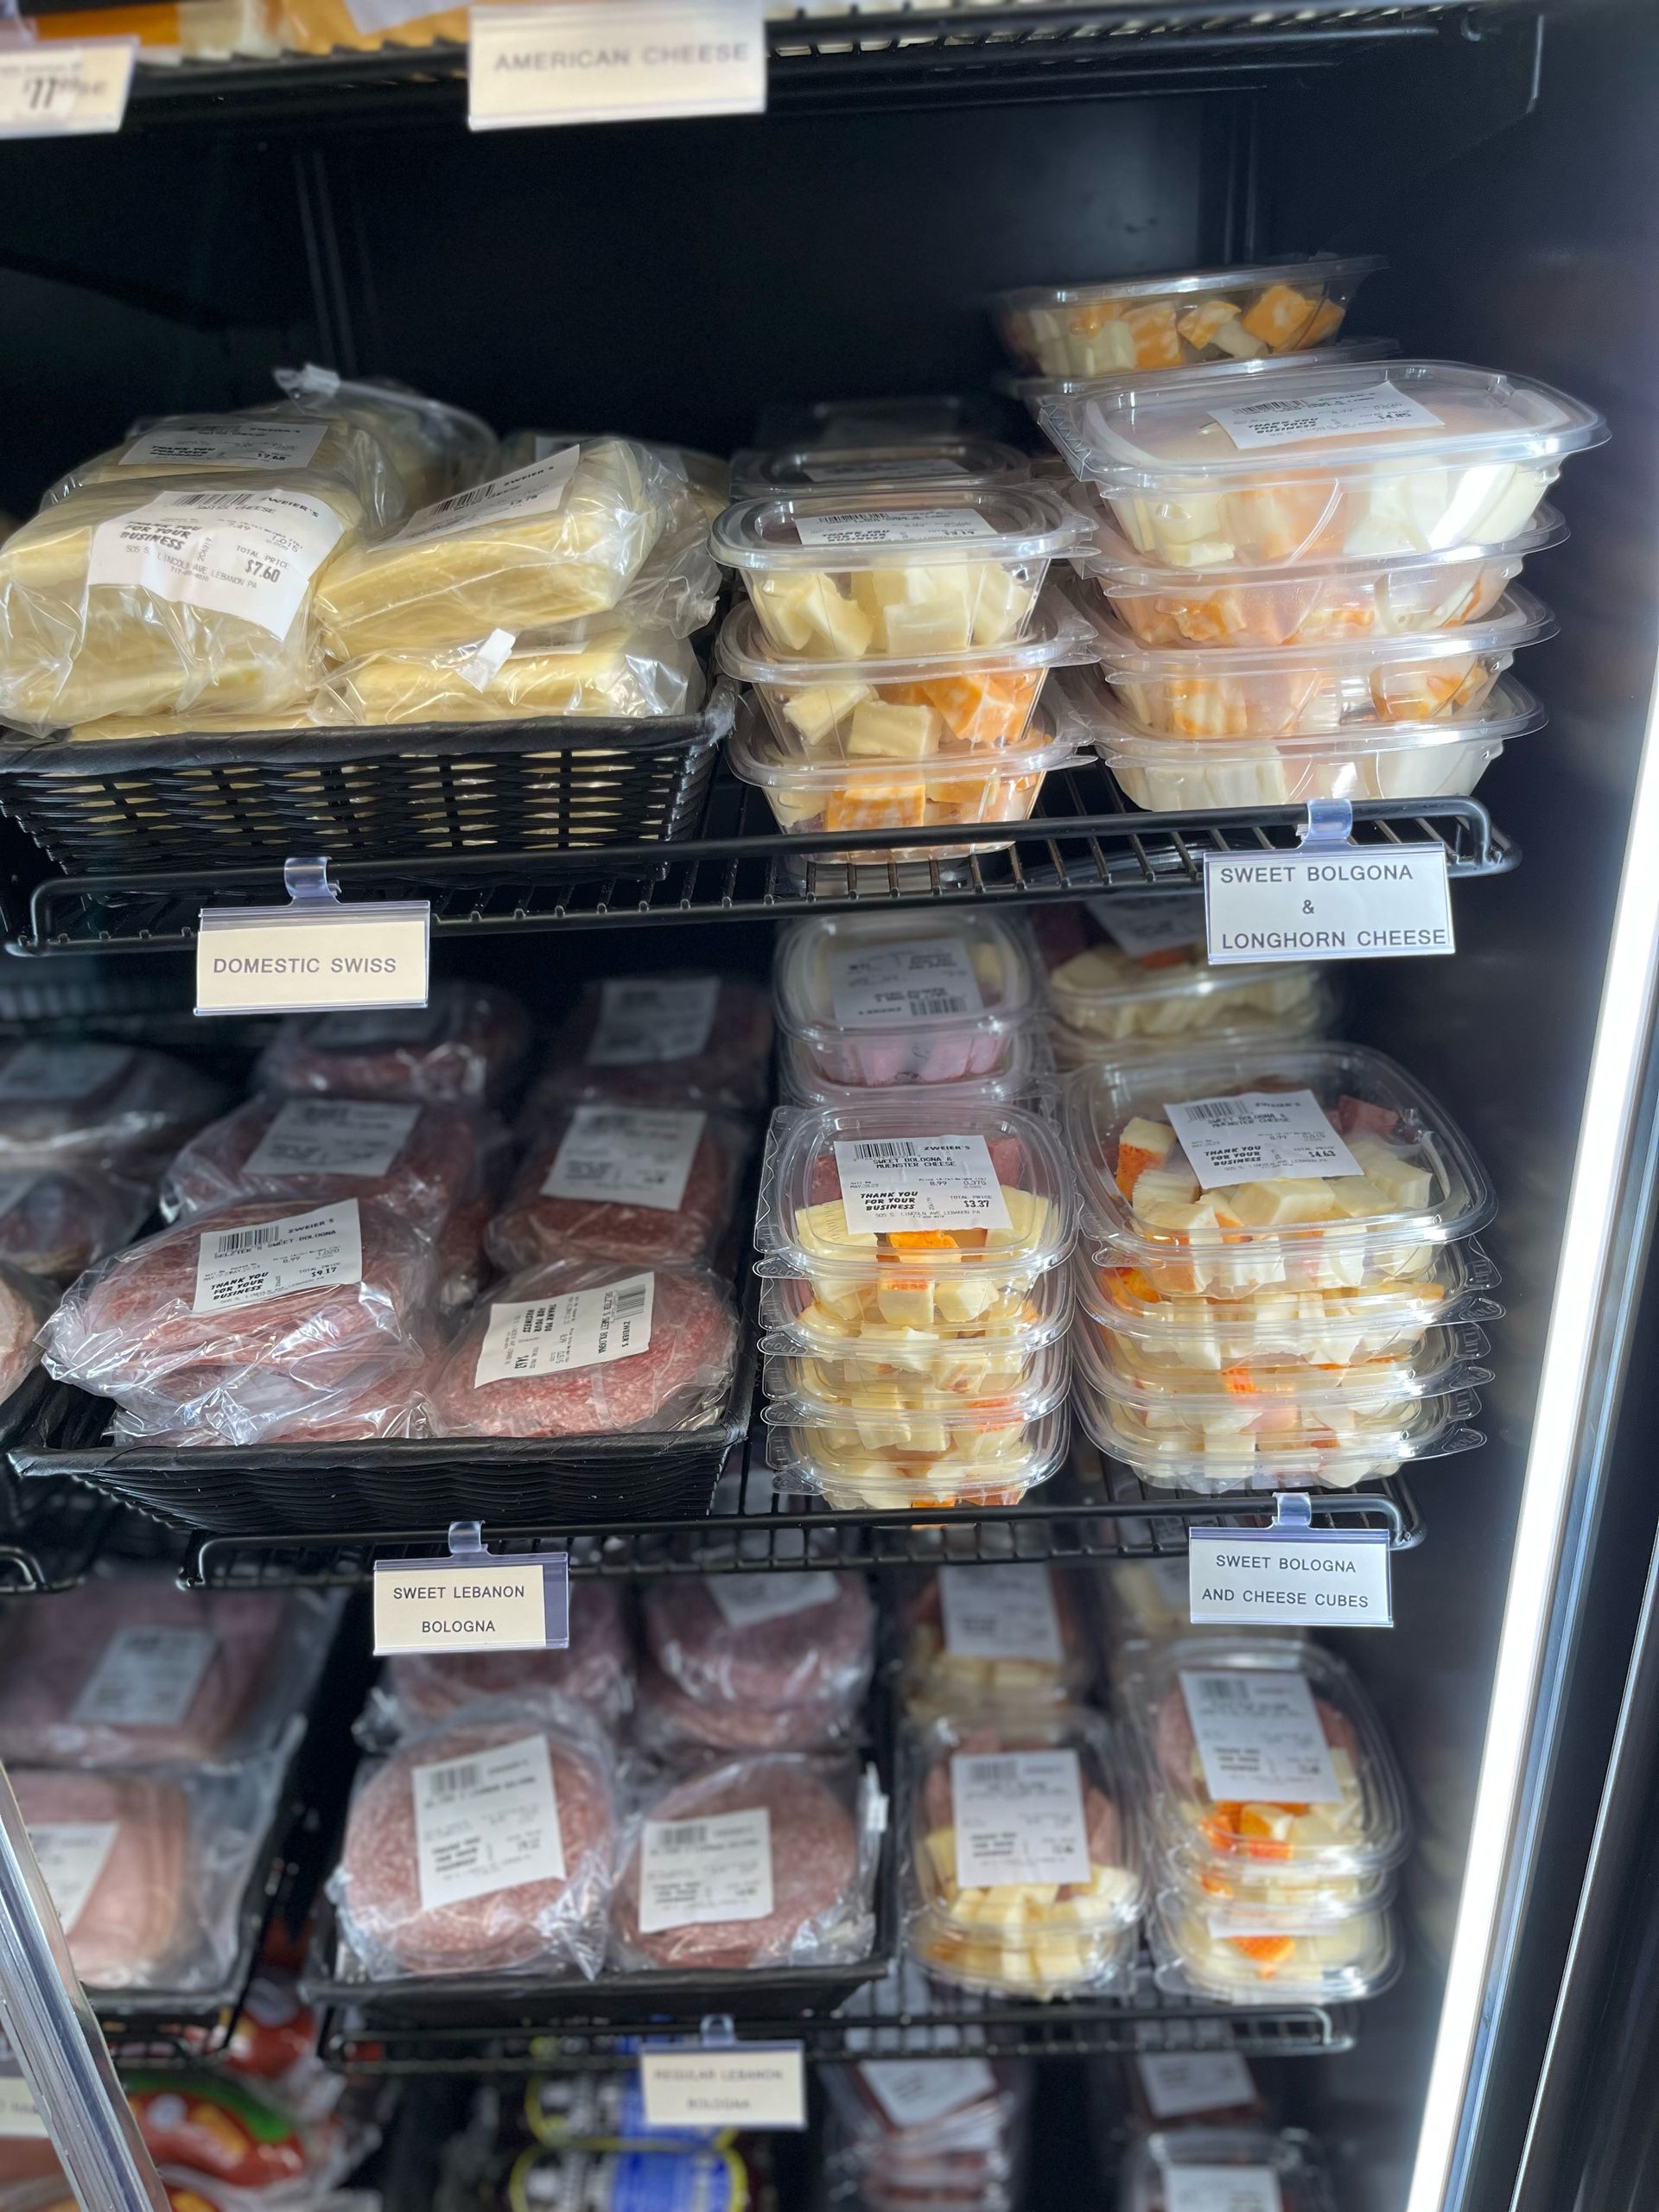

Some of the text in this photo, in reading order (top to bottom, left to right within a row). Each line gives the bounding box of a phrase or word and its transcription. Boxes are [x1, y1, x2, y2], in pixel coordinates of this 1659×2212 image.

[494, 41, 750, 72] AMERICAN CHEESE
[119, 531, 186, 551] BUSINESS
[156, 527, 192, 539] YOUR
[236, 545, 290, 569] TOTAL PRICE
[211, 569, 245, 586] LEBANON
[246, 580, 257, 588] PA
[245, 559, 281, 583] $7.60
[1220, 864, 1414, 884] SWEET BOLGONA
[1302, 899, 1314, 914] &
[1222, 928, 1446, 950] LONGHORN CHEESE
[213, 957, 397, 974] DOMESTIC SWISS
[1204, 1147, 1238, 1156] THANK
[1213, 1156, 1262, 1166] BUSINESS
[288, 1217, 334, 1234] ZWEIER'S
[299, 1230, 337, 1242] BOLOGNA
[211, 1277, 246, 1290] THANK
[249, 1271, 270, 1281] YOU
[213, 1286, 234, 1294] FOR
[238, 1279, 265, 1289] YOUR
[213, 1285, 263, 1300] BUSINESS
[523, 1309, 535, 1332] BUSINESS
[533, 1318, 543, 1332] YOUR
[544, 1322, 553, 1332] YOU
[622, 1320, 631, 1347] ZWEIER'S
[1216, 1554, 1357, 1573] SWEET BOLOGNA
[393, 1586, 525, 1599] SWEET LEBANON
[1202, 1588, 1369, 1608] AND CHEESE CUBES
[422, 1620, 496, 1633] BOLOGNA
